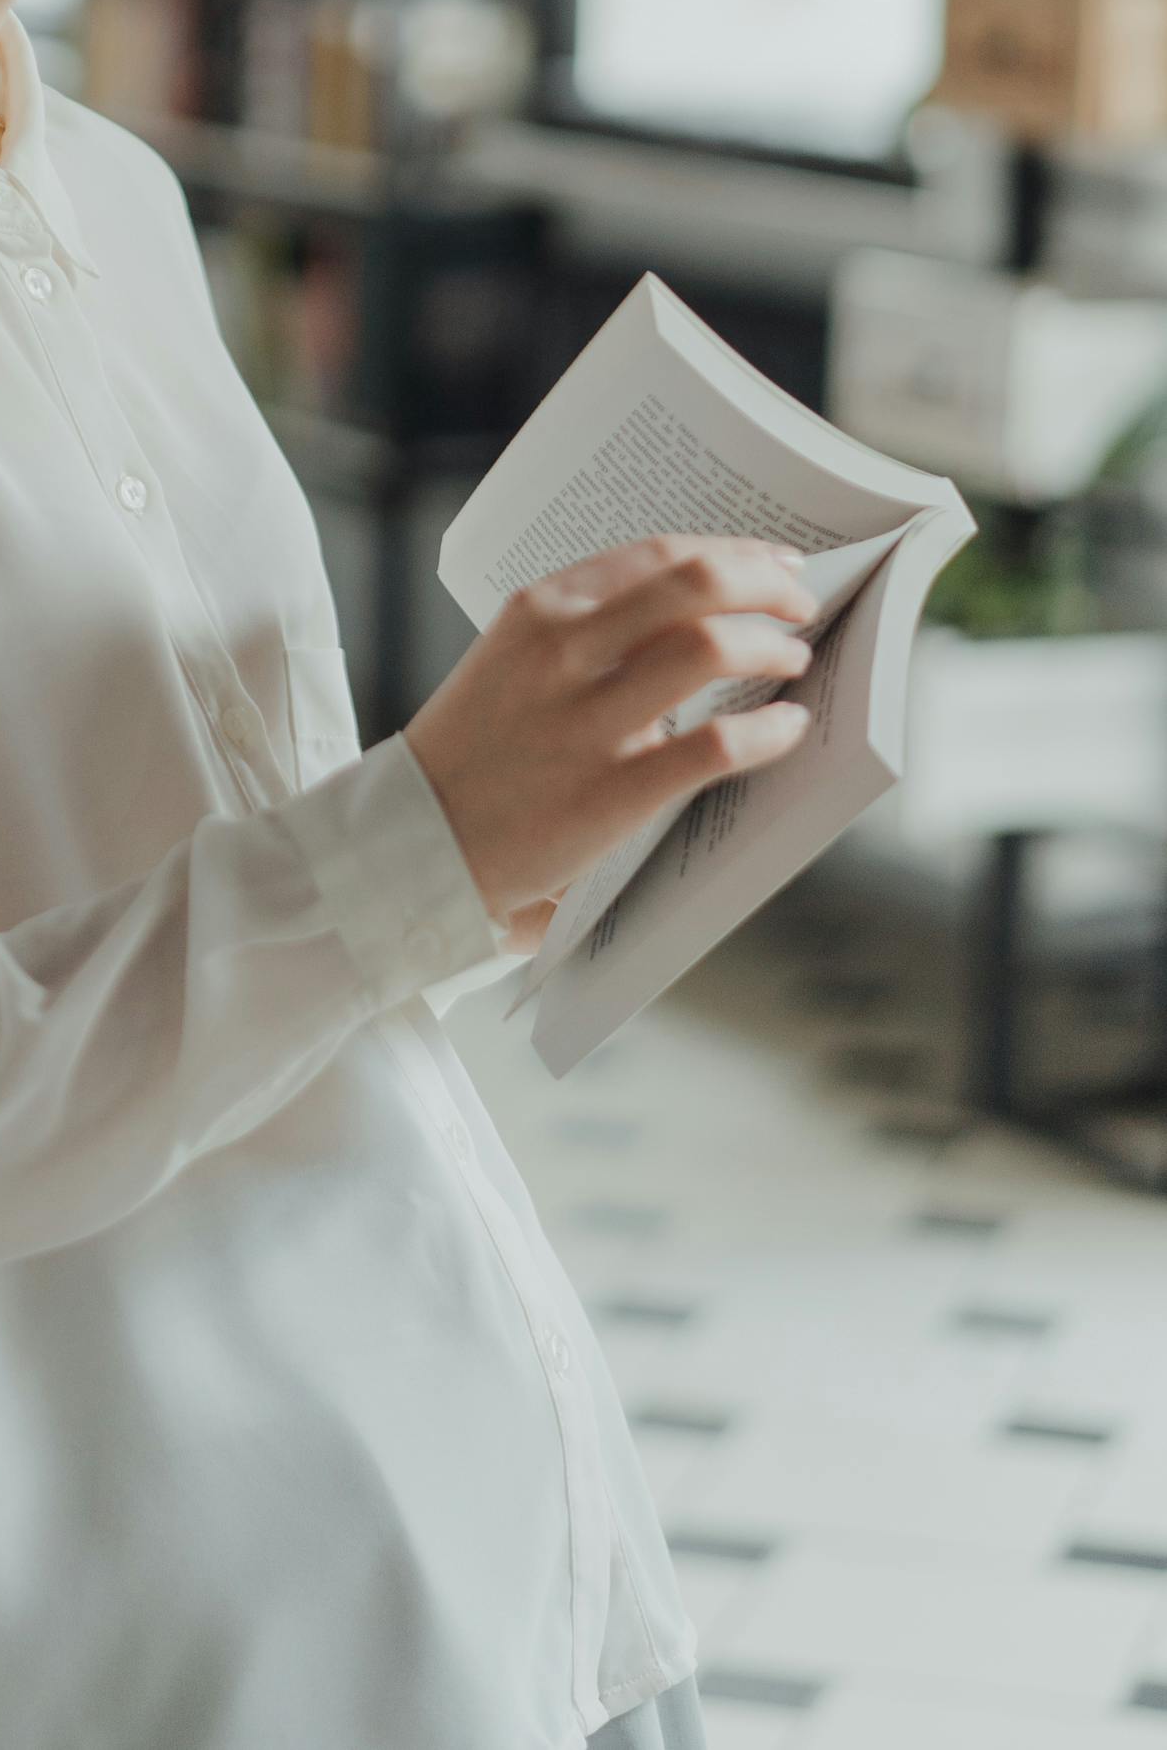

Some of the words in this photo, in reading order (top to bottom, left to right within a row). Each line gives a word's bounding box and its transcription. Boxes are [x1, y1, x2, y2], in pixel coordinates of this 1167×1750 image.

[661, 453, 685, 477] dans
[661, 421, 673, 435] de
[756, 502, 780, 523] fond
[783, 521, 808, 539] dans
[703, 447, 755, 491] impossible
[757, 489, 771, 502] de
[774, 502, 787, 512] se
[740, 506, 761, 525] que
